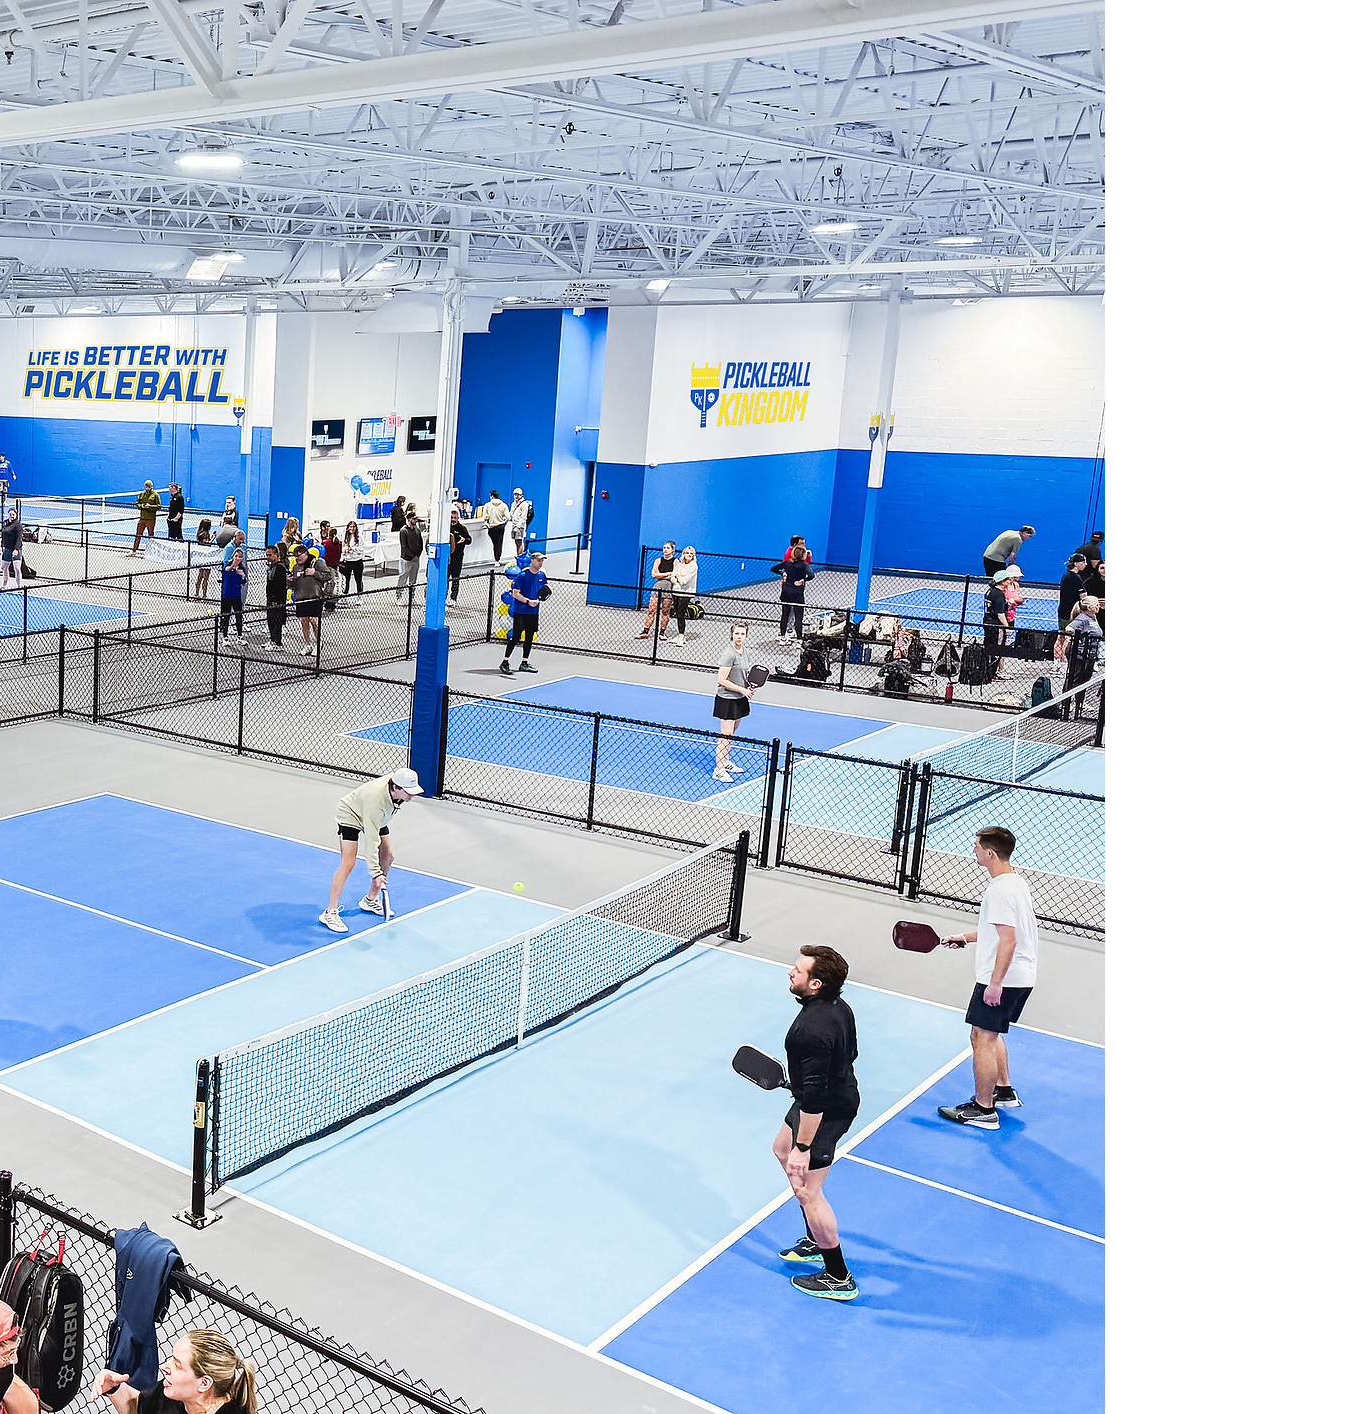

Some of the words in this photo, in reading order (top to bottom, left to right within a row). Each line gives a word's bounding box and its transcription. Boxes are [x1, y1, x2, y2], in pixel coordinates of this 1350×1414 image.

[27, 350, 60, 366] LIFE
[63, 350, 79, 366] IS
[84, 344, 170, 366] BETTER
[175, 348, 228, 366] WITH
[23, 369, 230, 403] PICKLEBALL
[722, 361, 811, 389] PICKLEBALL
[716, 390, 809, 427] KINGDOM
[62, 1302, 78, 1362] CRBN
